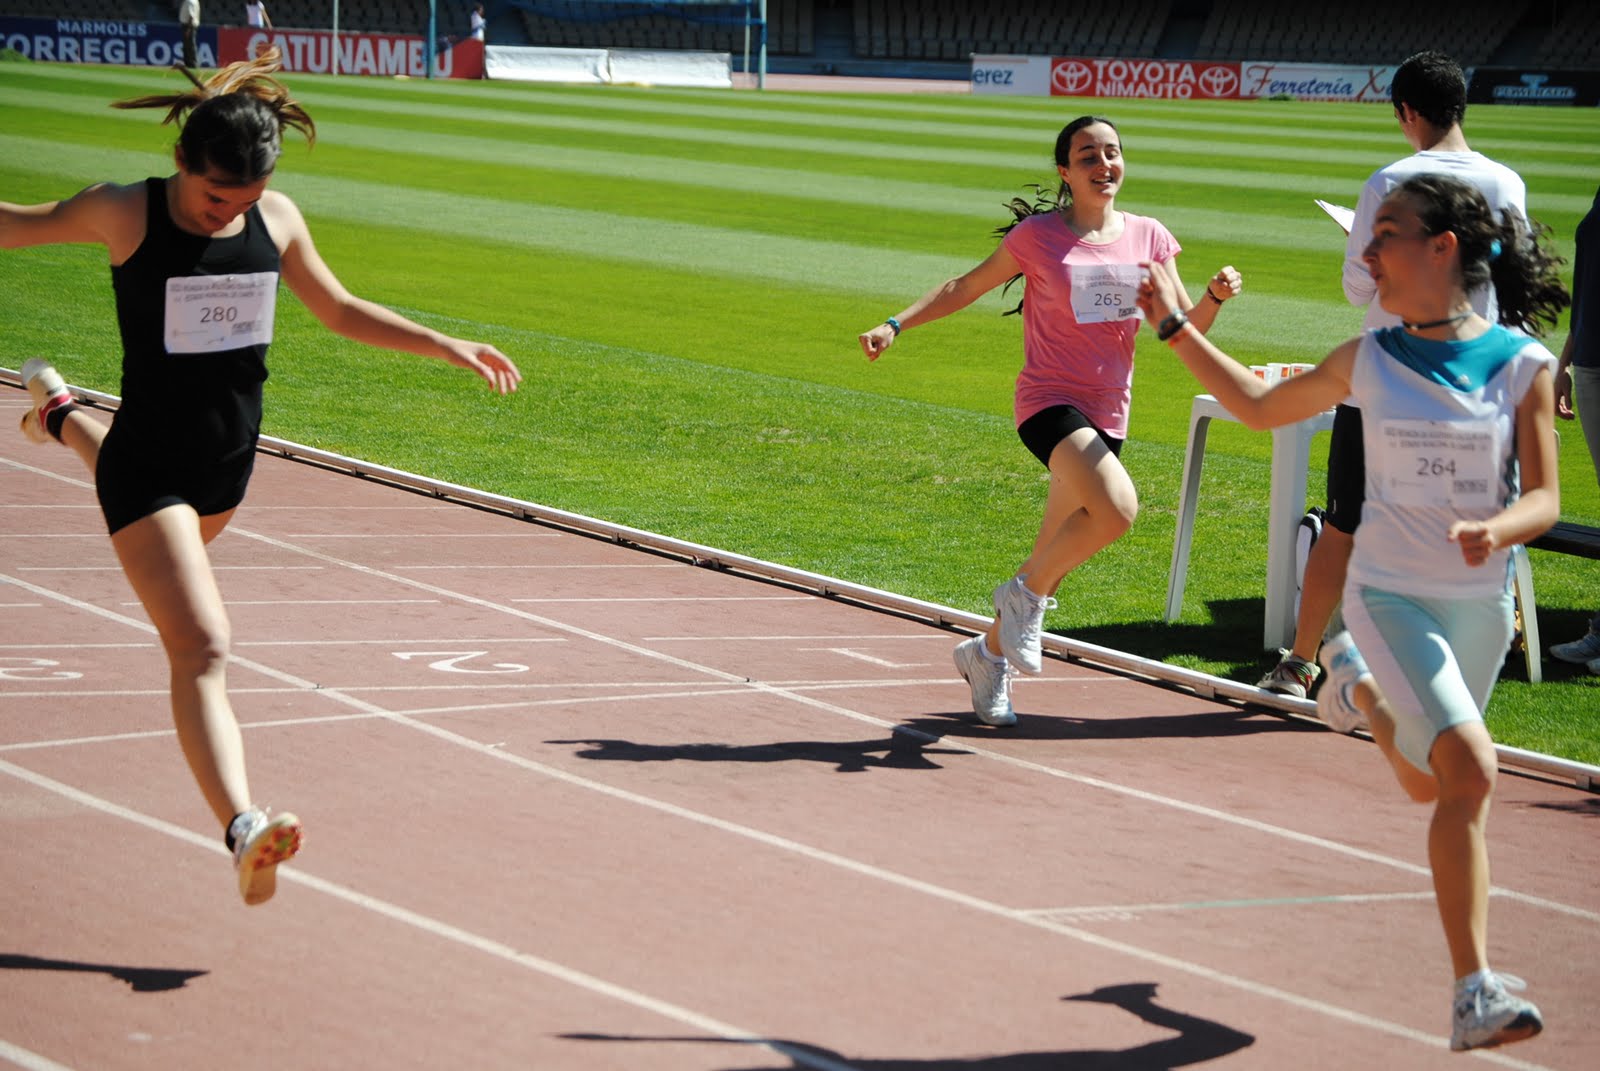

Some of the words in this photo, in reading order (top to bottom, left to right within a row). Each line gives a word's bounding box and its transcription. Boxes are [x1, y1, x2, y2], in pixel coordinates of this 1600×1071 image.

[58, 20, 147, 36] MARMOLES
[0, 33, 216, 67] ORREGLOSA
[973, 69, 1013, 84] erez
[1094, 60, 1195, 82] TOYOTA
[1246, 64, 1354, 95] Ferretería
[1095, 81, 1192, 98] NIMAUTO
[1094, 293, 1122, 306] 265
[200, 306, 238, 323] 280
[1417, 457, 1456, 476] 264
[391, 651, 530, 674] 2
